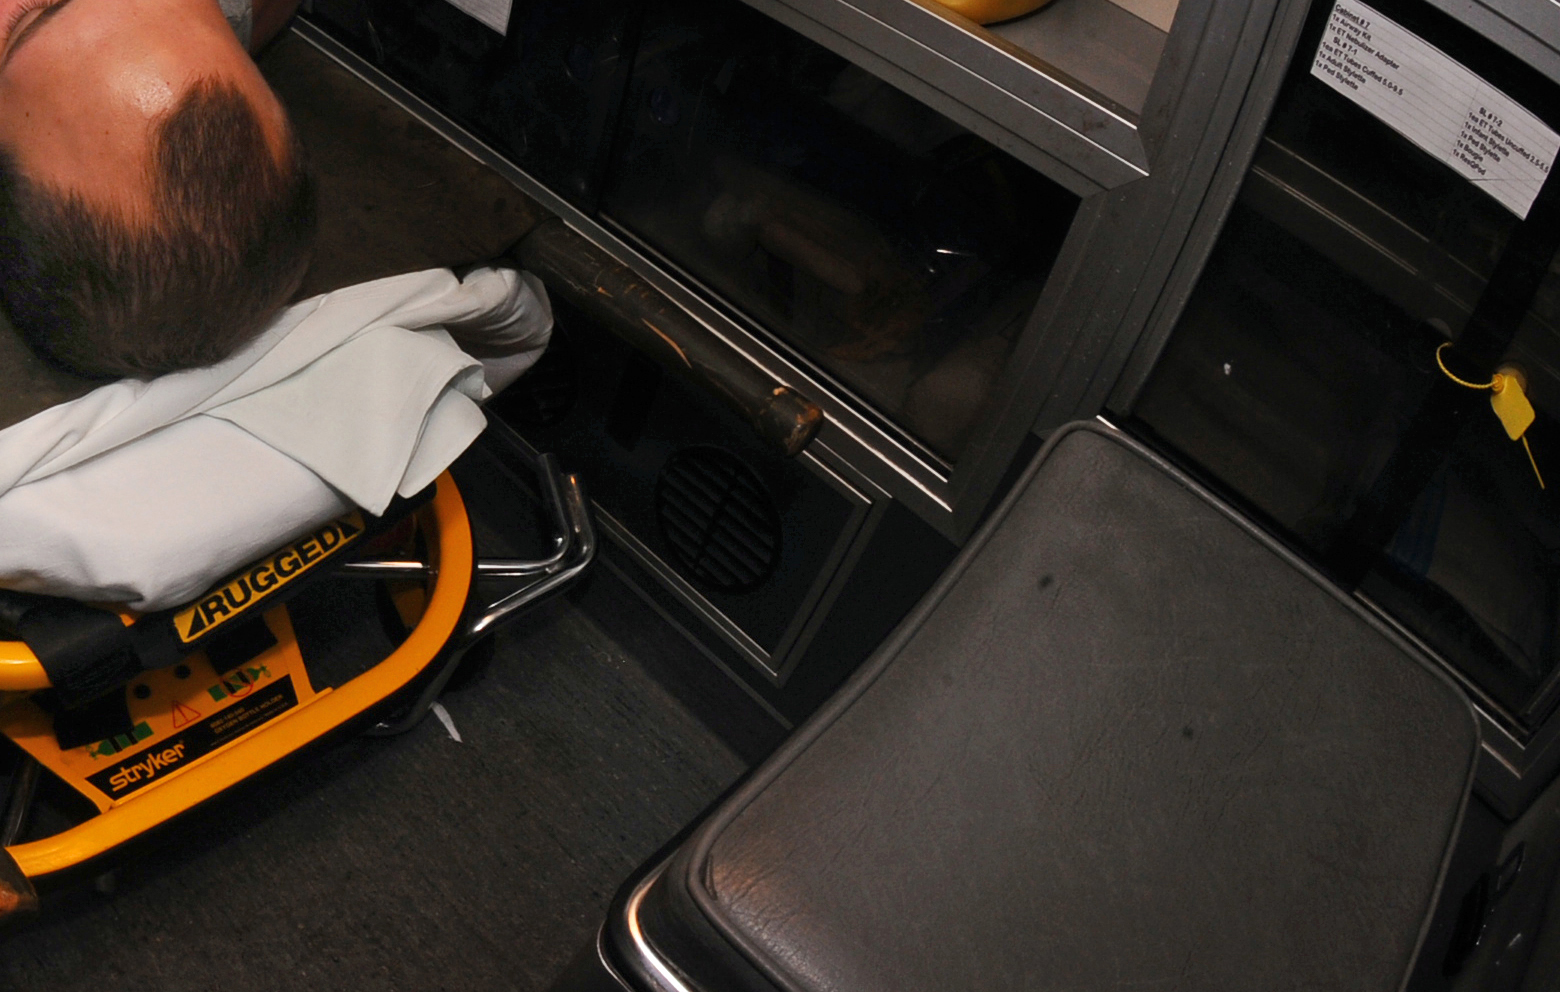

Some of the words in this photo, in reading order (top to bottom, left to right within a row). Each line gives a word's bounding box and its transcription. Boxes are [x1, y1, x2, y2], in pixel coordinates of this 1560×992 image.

[1334, 2, 1360, 23] Cabinet
[1339, 17, 1361, 37] Airway
[1345, 31, 1374, 55] Nebulizer
[1374, 49, 1399, 71] Adapter
[1326, 54, 1342, 69] Adult
[1342, 64, 1366, 85] Stylette
[1335, 70, 1358, 91] Stylette
[1342, 53, 1361, 70] Tubes
[1361, 65, 1382, 83] Cuffed
[1462, 144, 1483, 163] Bougie
[1472, 126, 1488, 142] Infant
[1487, 138, 1510, 158] Stylette
[1478, 143, 1501, 163] Stylette
[1487, 125, 1505, 142] Tubes
[1504, 137, 1531, 159] Uncuffed
[204, 524, 341, 626] RUGGED
[260, 694, 283, 709] HOLDER
[108, 741, 184, 792] stryker
